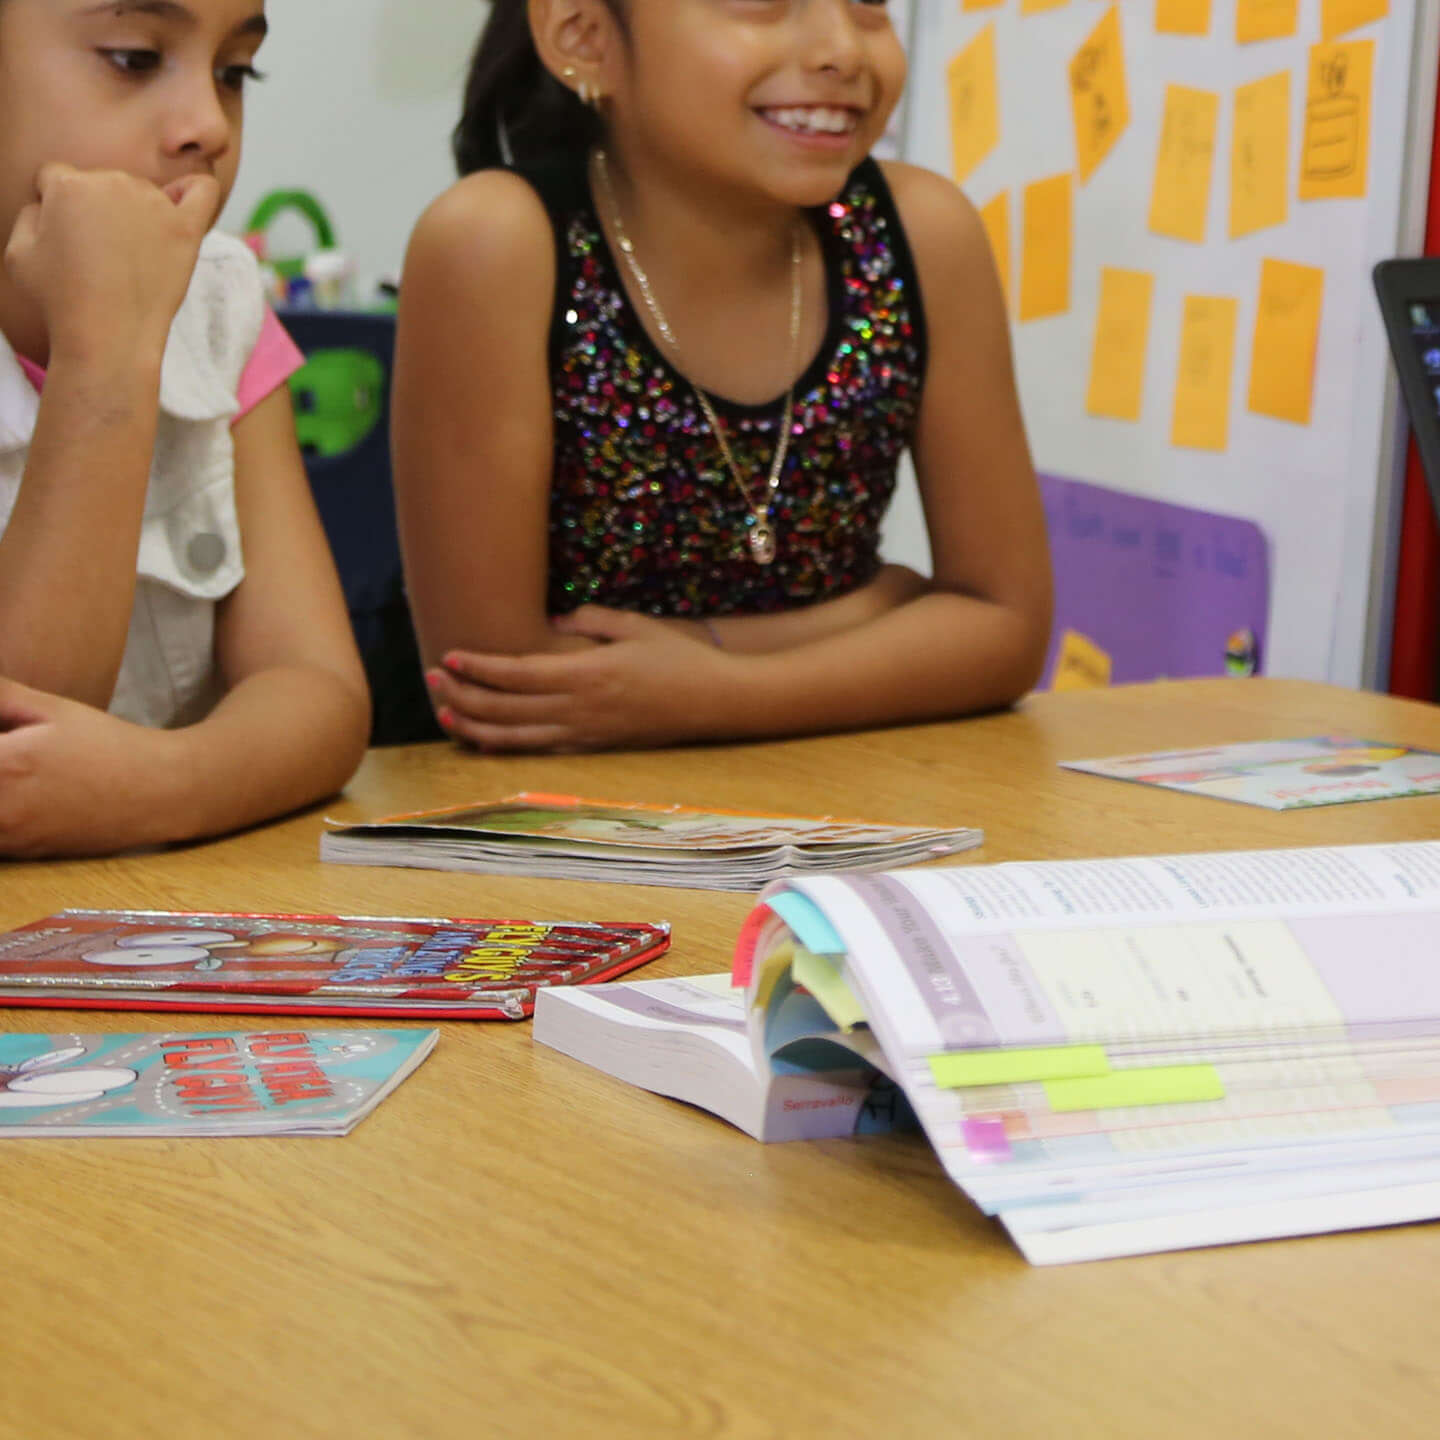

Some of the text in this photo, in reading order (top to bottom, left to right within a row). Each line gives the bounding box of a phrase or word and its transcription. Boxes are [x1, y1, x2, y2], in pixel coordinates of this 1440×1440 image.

[328, 945, 410, 982] TRICKS
[394, 929, 481, 975] AMAZING
[444, 924, 554, 982] FLY GUY'S
[244, 1031, 317, 1059] FLY
[159, 1037, 268, 1116] FLY GUY!
